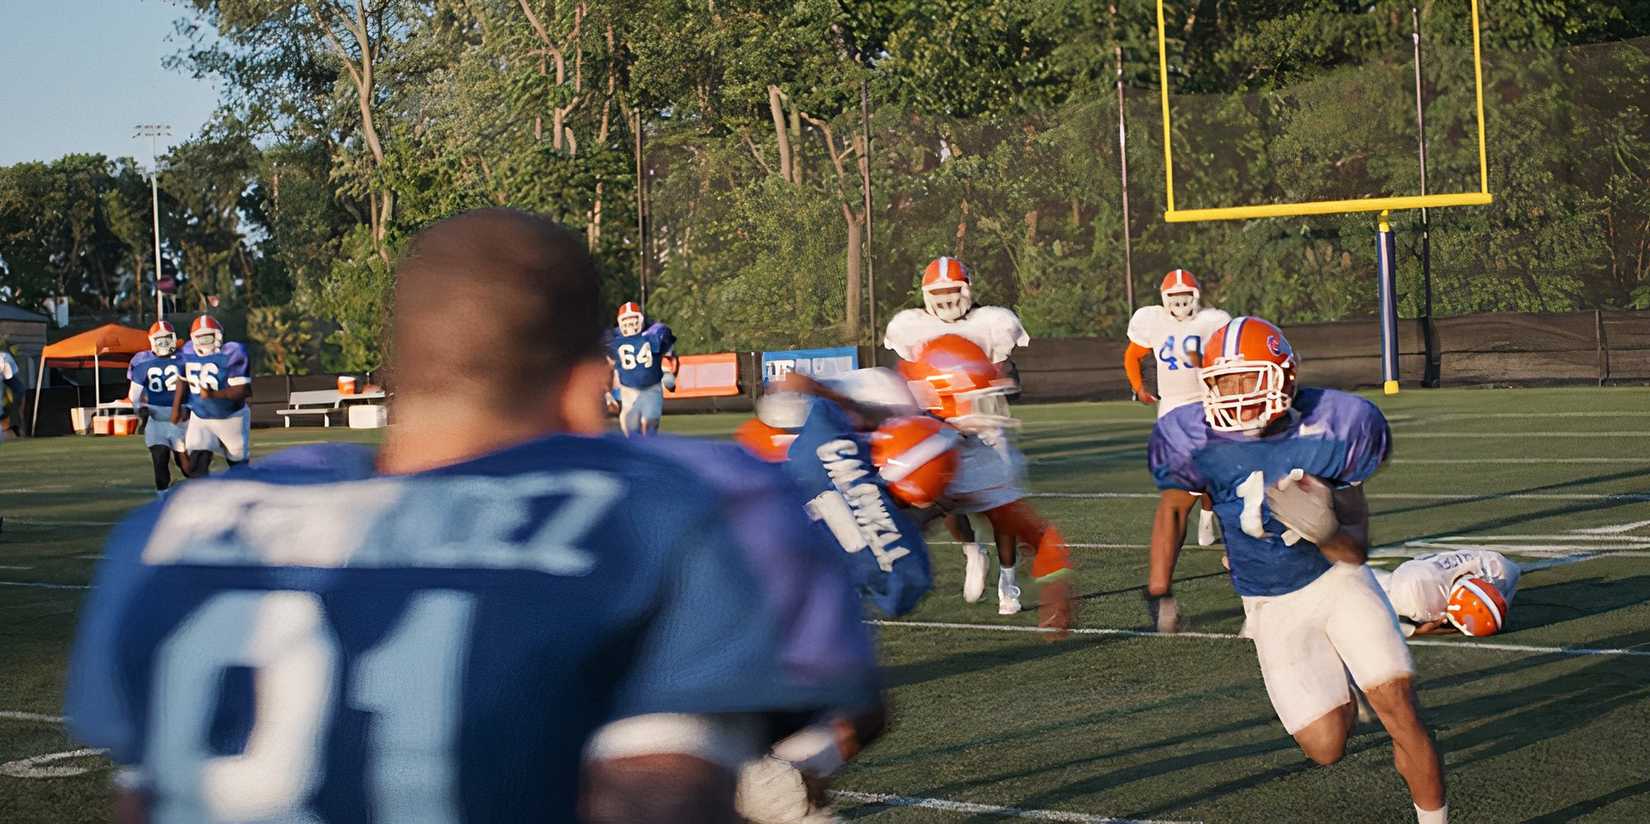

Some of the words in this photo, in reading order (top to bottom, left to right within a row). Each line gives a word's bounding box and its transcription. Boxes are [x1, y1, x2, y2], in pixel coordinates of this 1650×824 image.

[618, 343, 653, 370] 64
[148, 365, 178, 392] 62
[186, 363, 218, 394] 56
